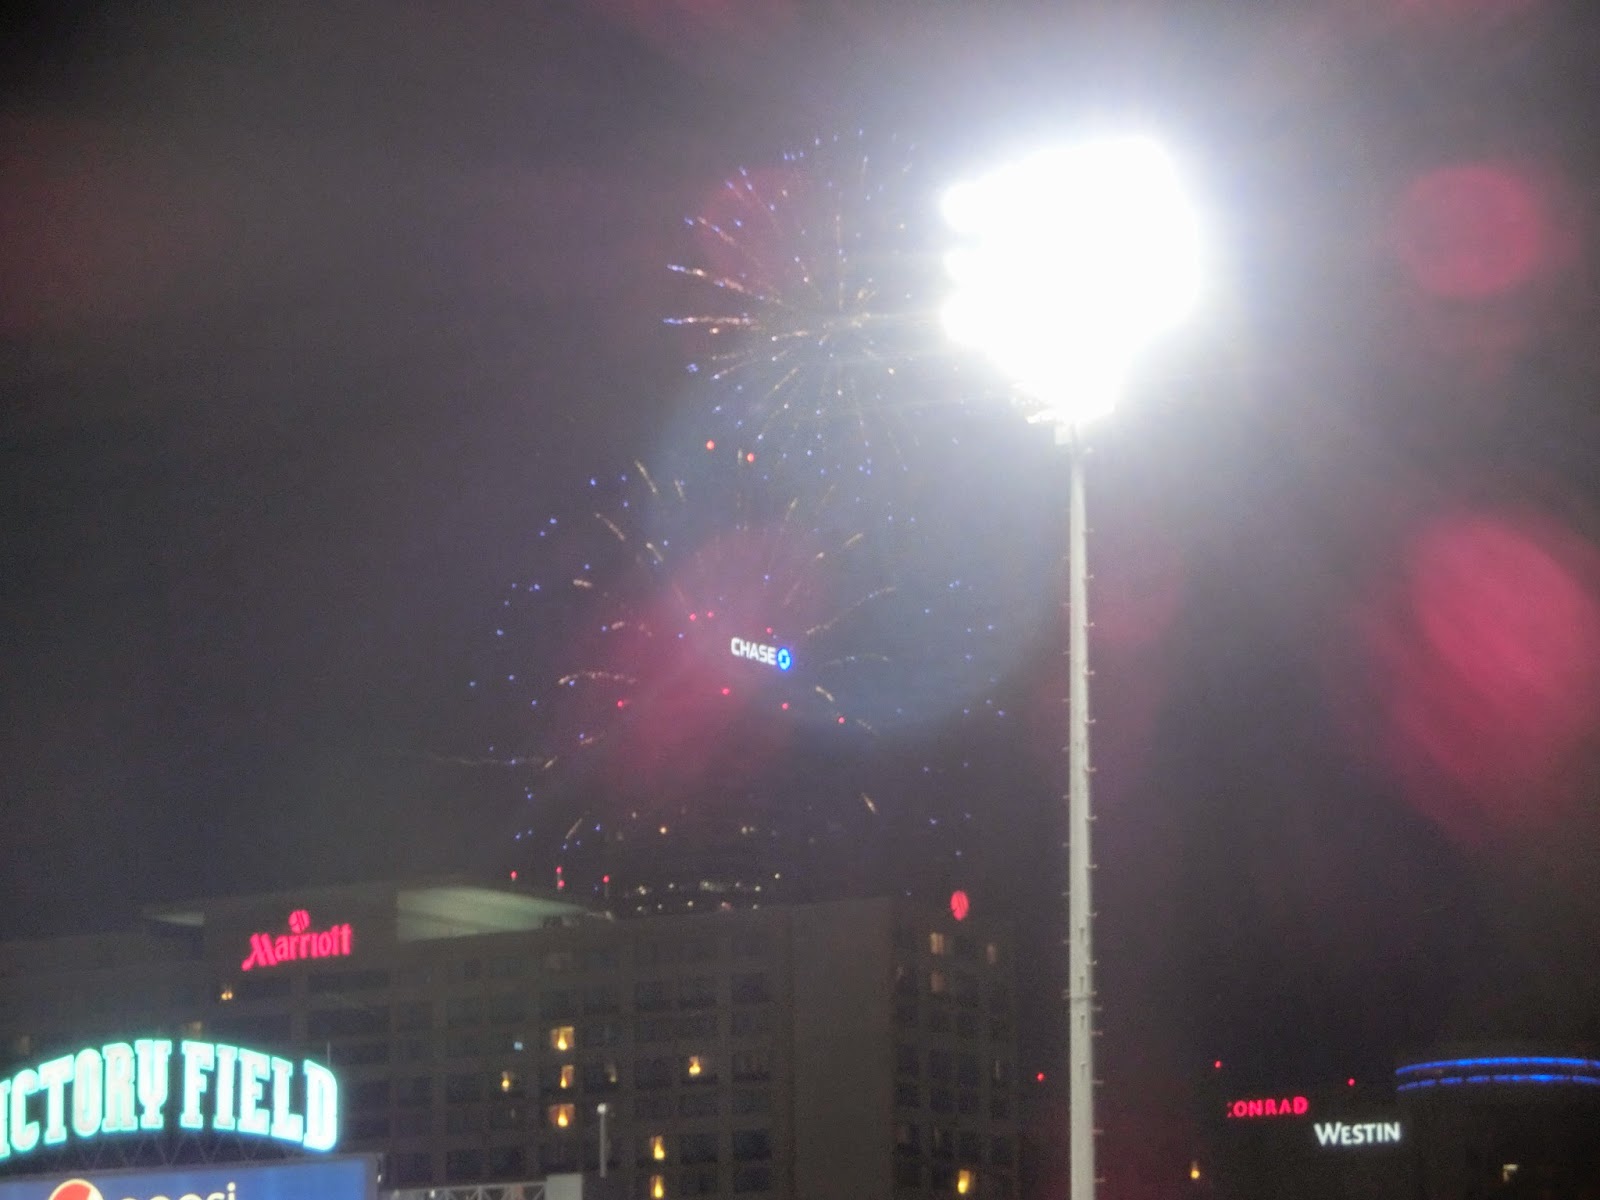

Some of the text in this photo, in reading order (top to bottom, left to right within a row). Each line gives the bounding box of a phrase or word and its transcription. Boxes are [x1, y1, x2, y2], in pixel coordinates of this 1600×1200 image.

[730, 637, 776, 666] CHASE
[241, 923, 352, 971] Marriott
[179, 1038, 338, 1152] FIELD
[1227, 1096, 1309, 1117] ONRAD
[1314, 1121, 1401, 1146] WESTIN
